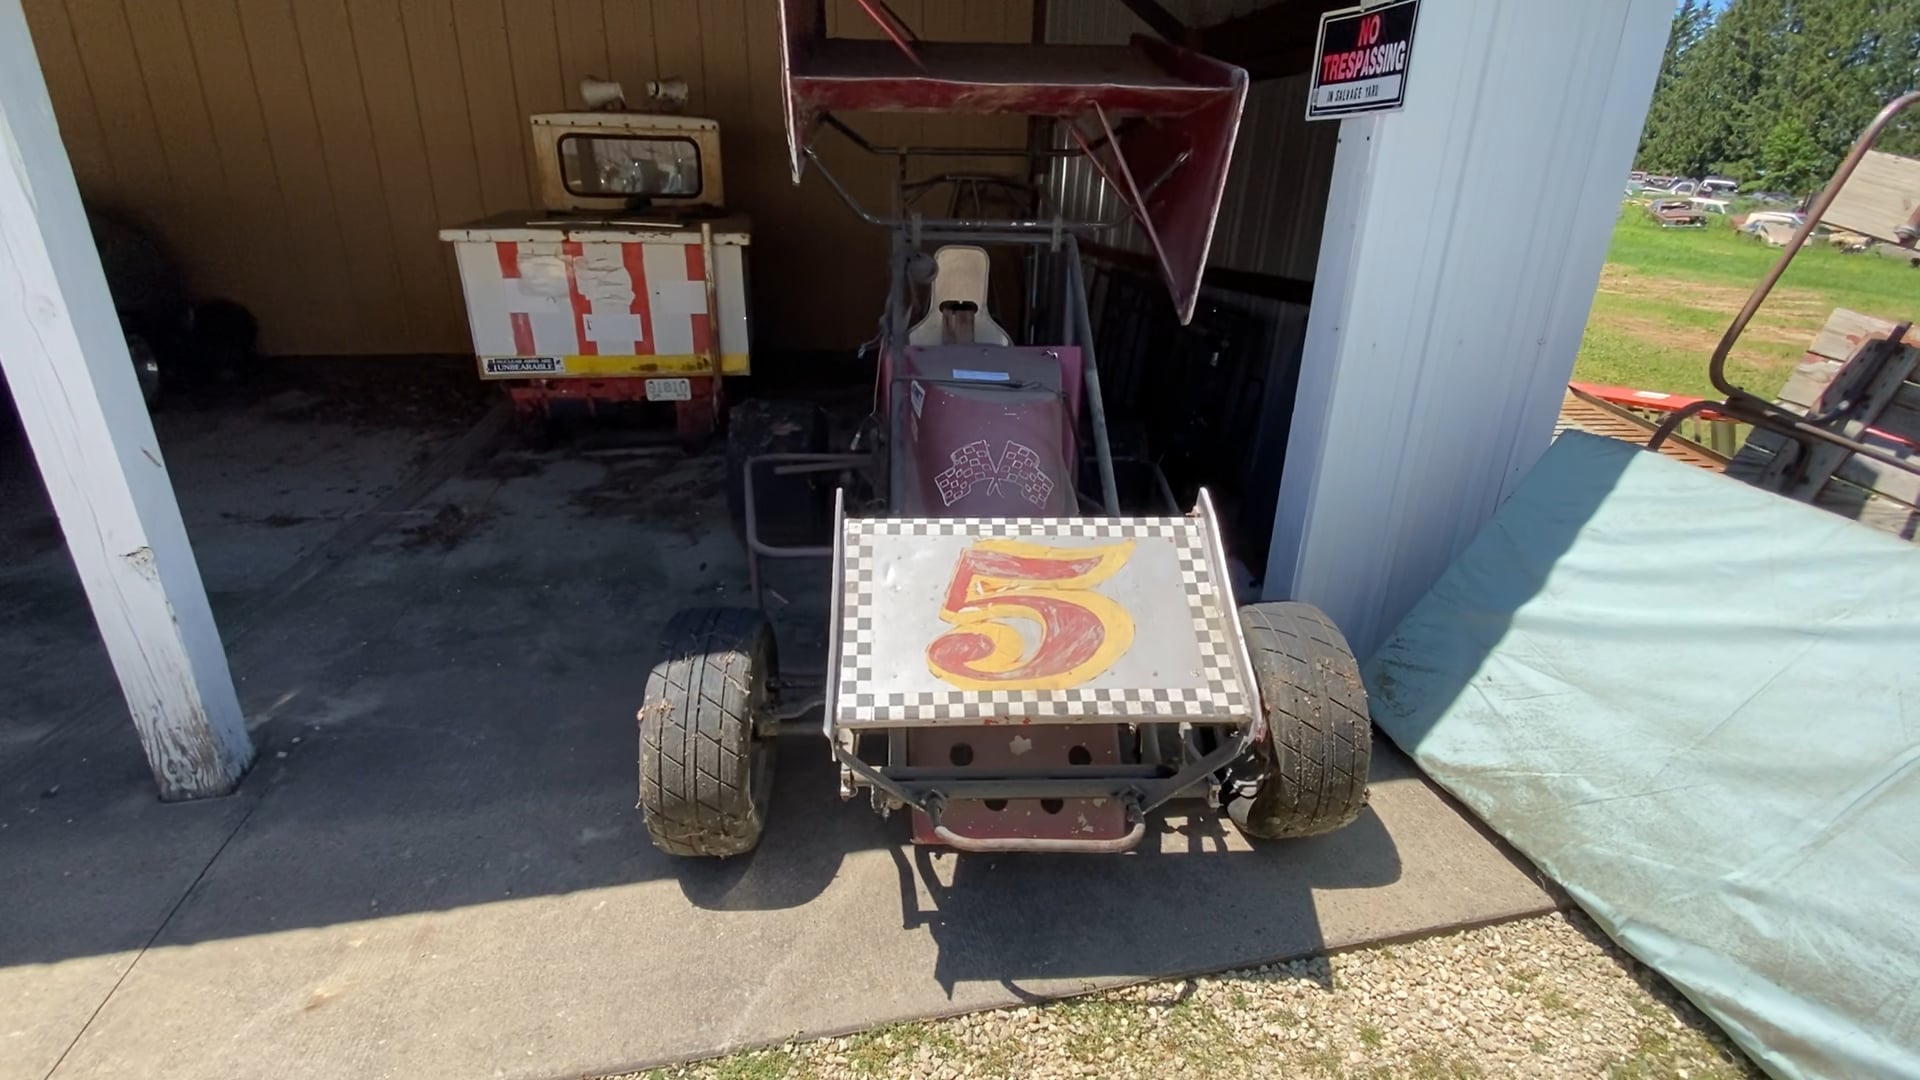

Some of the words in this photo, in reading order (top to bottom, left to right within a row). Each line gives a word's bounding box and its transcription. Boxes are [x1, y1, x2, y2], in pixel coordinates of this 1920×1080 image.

[1357, 14, 1381, 47] NO
[1322, 40, 1407, 82] TRESPASSING
[1326, 90, 1334, 102] IN
[1335, 86, 1362, 102] SALVAGE
[1365, 84, 1379, 97] YARD
[926, 537, 1137, 690] 5
